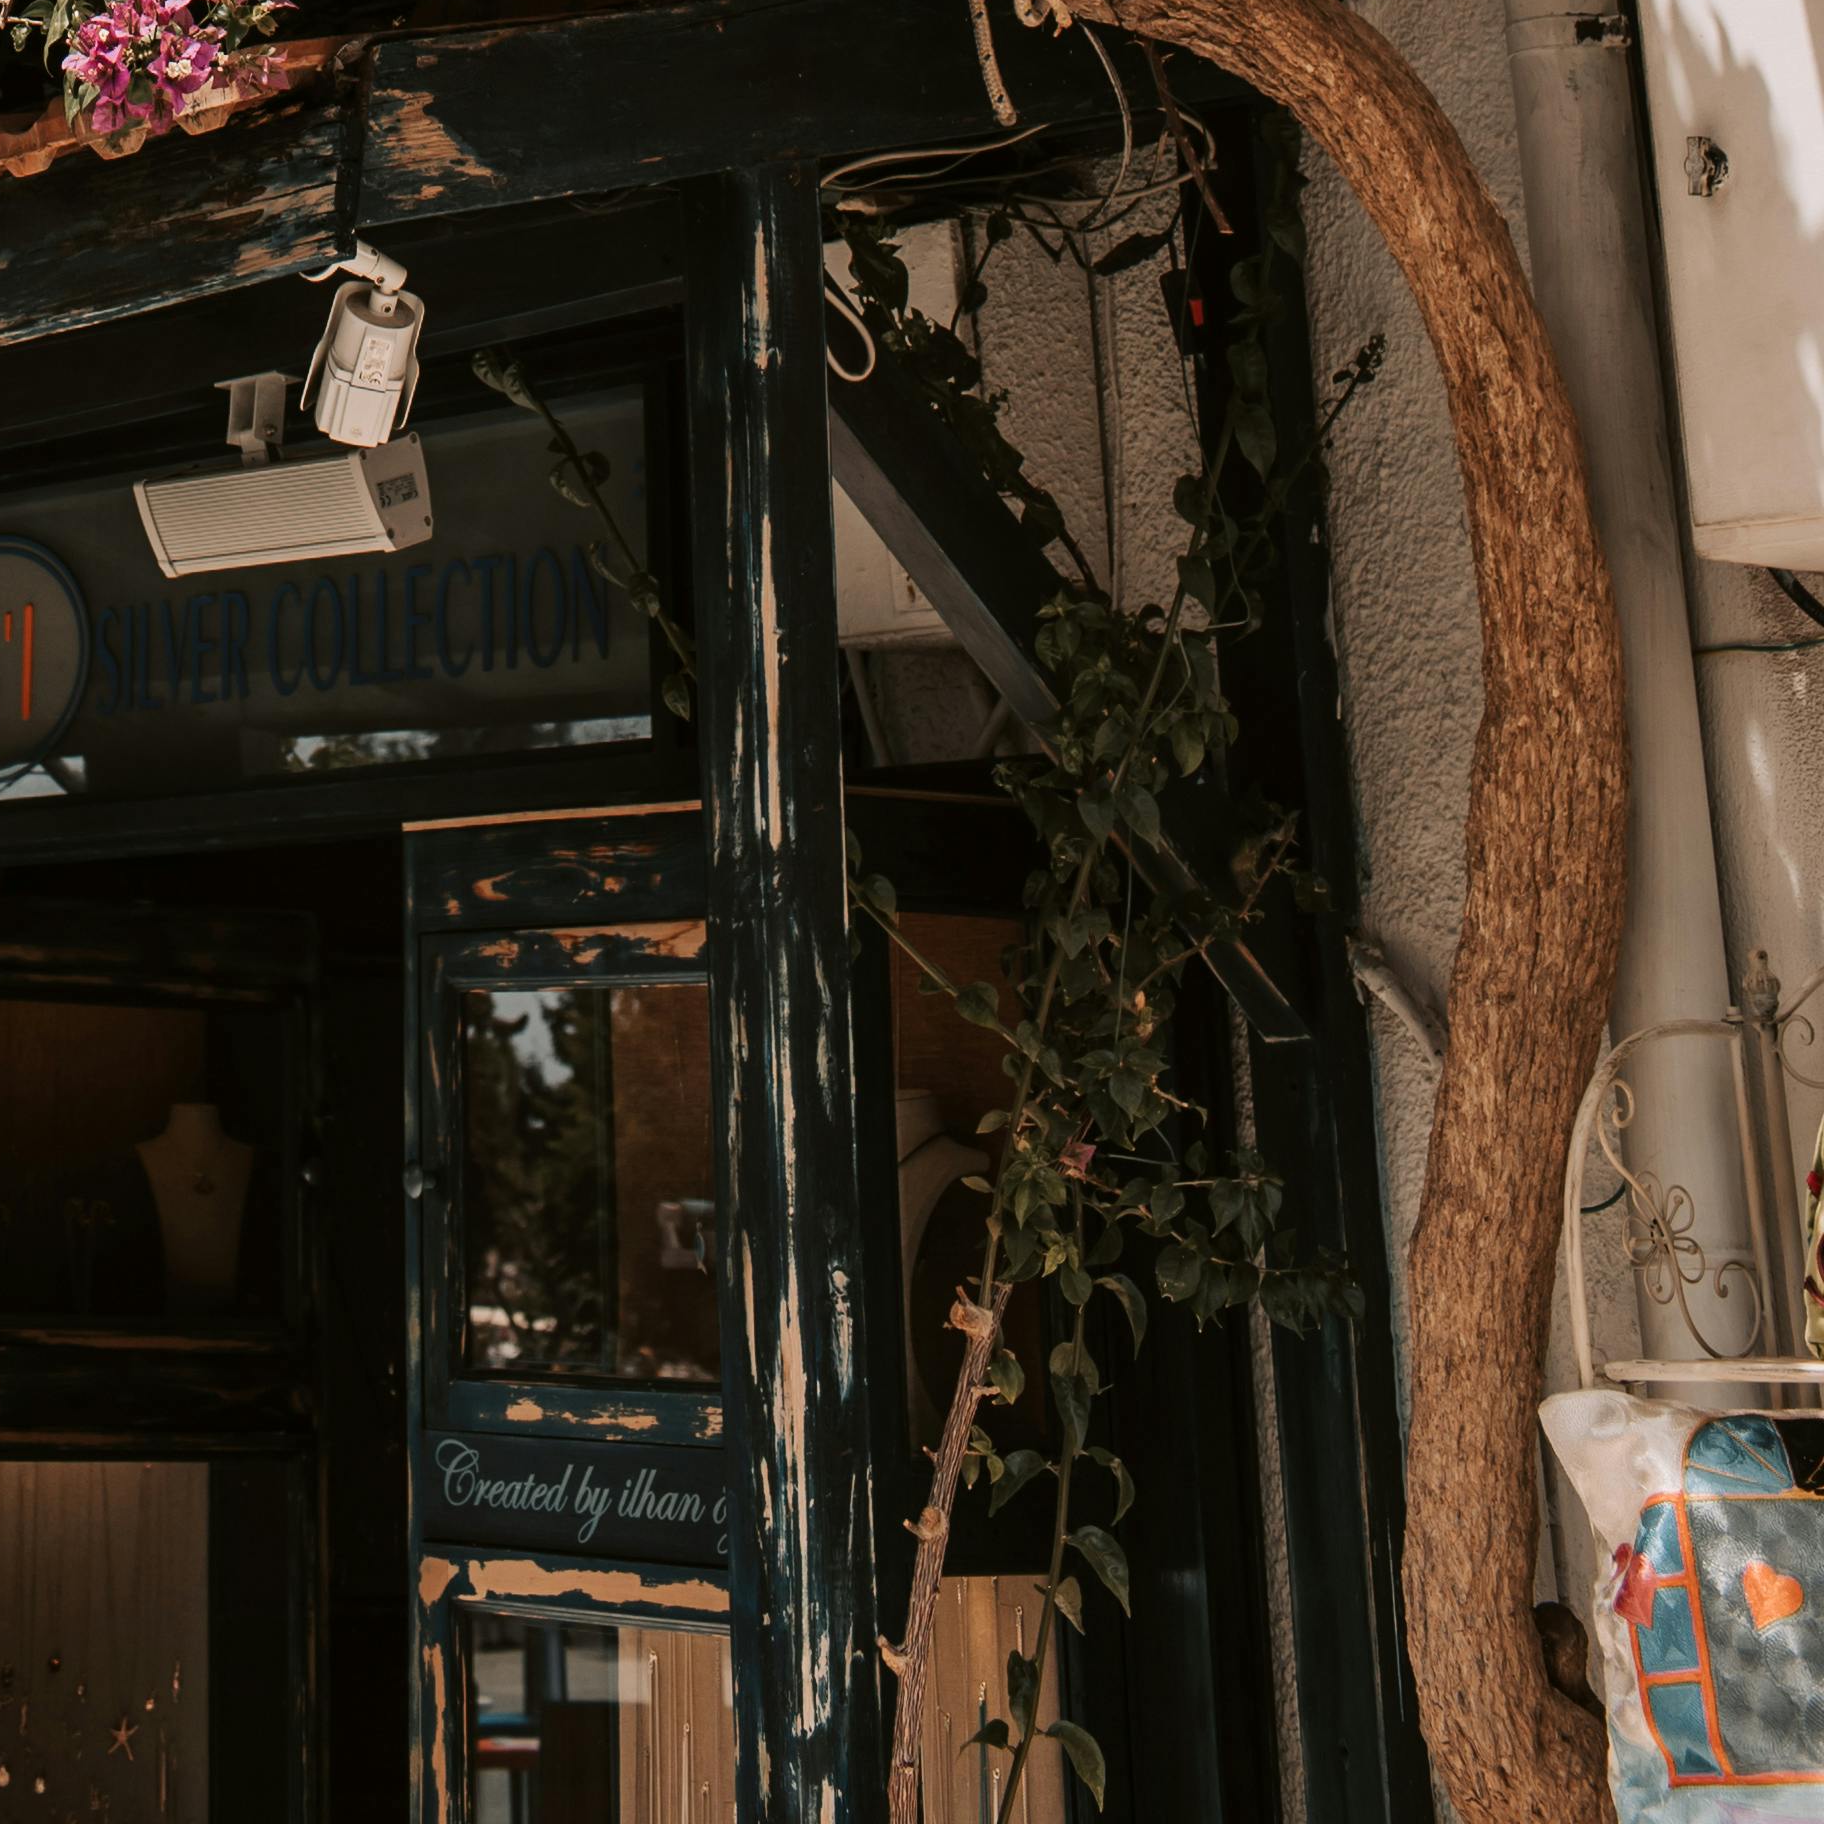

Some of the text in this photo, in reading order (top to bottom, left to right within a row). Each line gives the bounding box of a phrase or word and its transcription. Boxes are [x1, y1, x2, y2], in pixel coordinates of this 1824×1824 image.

[92, 542, 612, 717] SILVER COLLECTION
[434, 1437, 575, 1513] Created
[574, 1464, 614, 1545] by
[617, 1467, 707, 1524] ilhan
